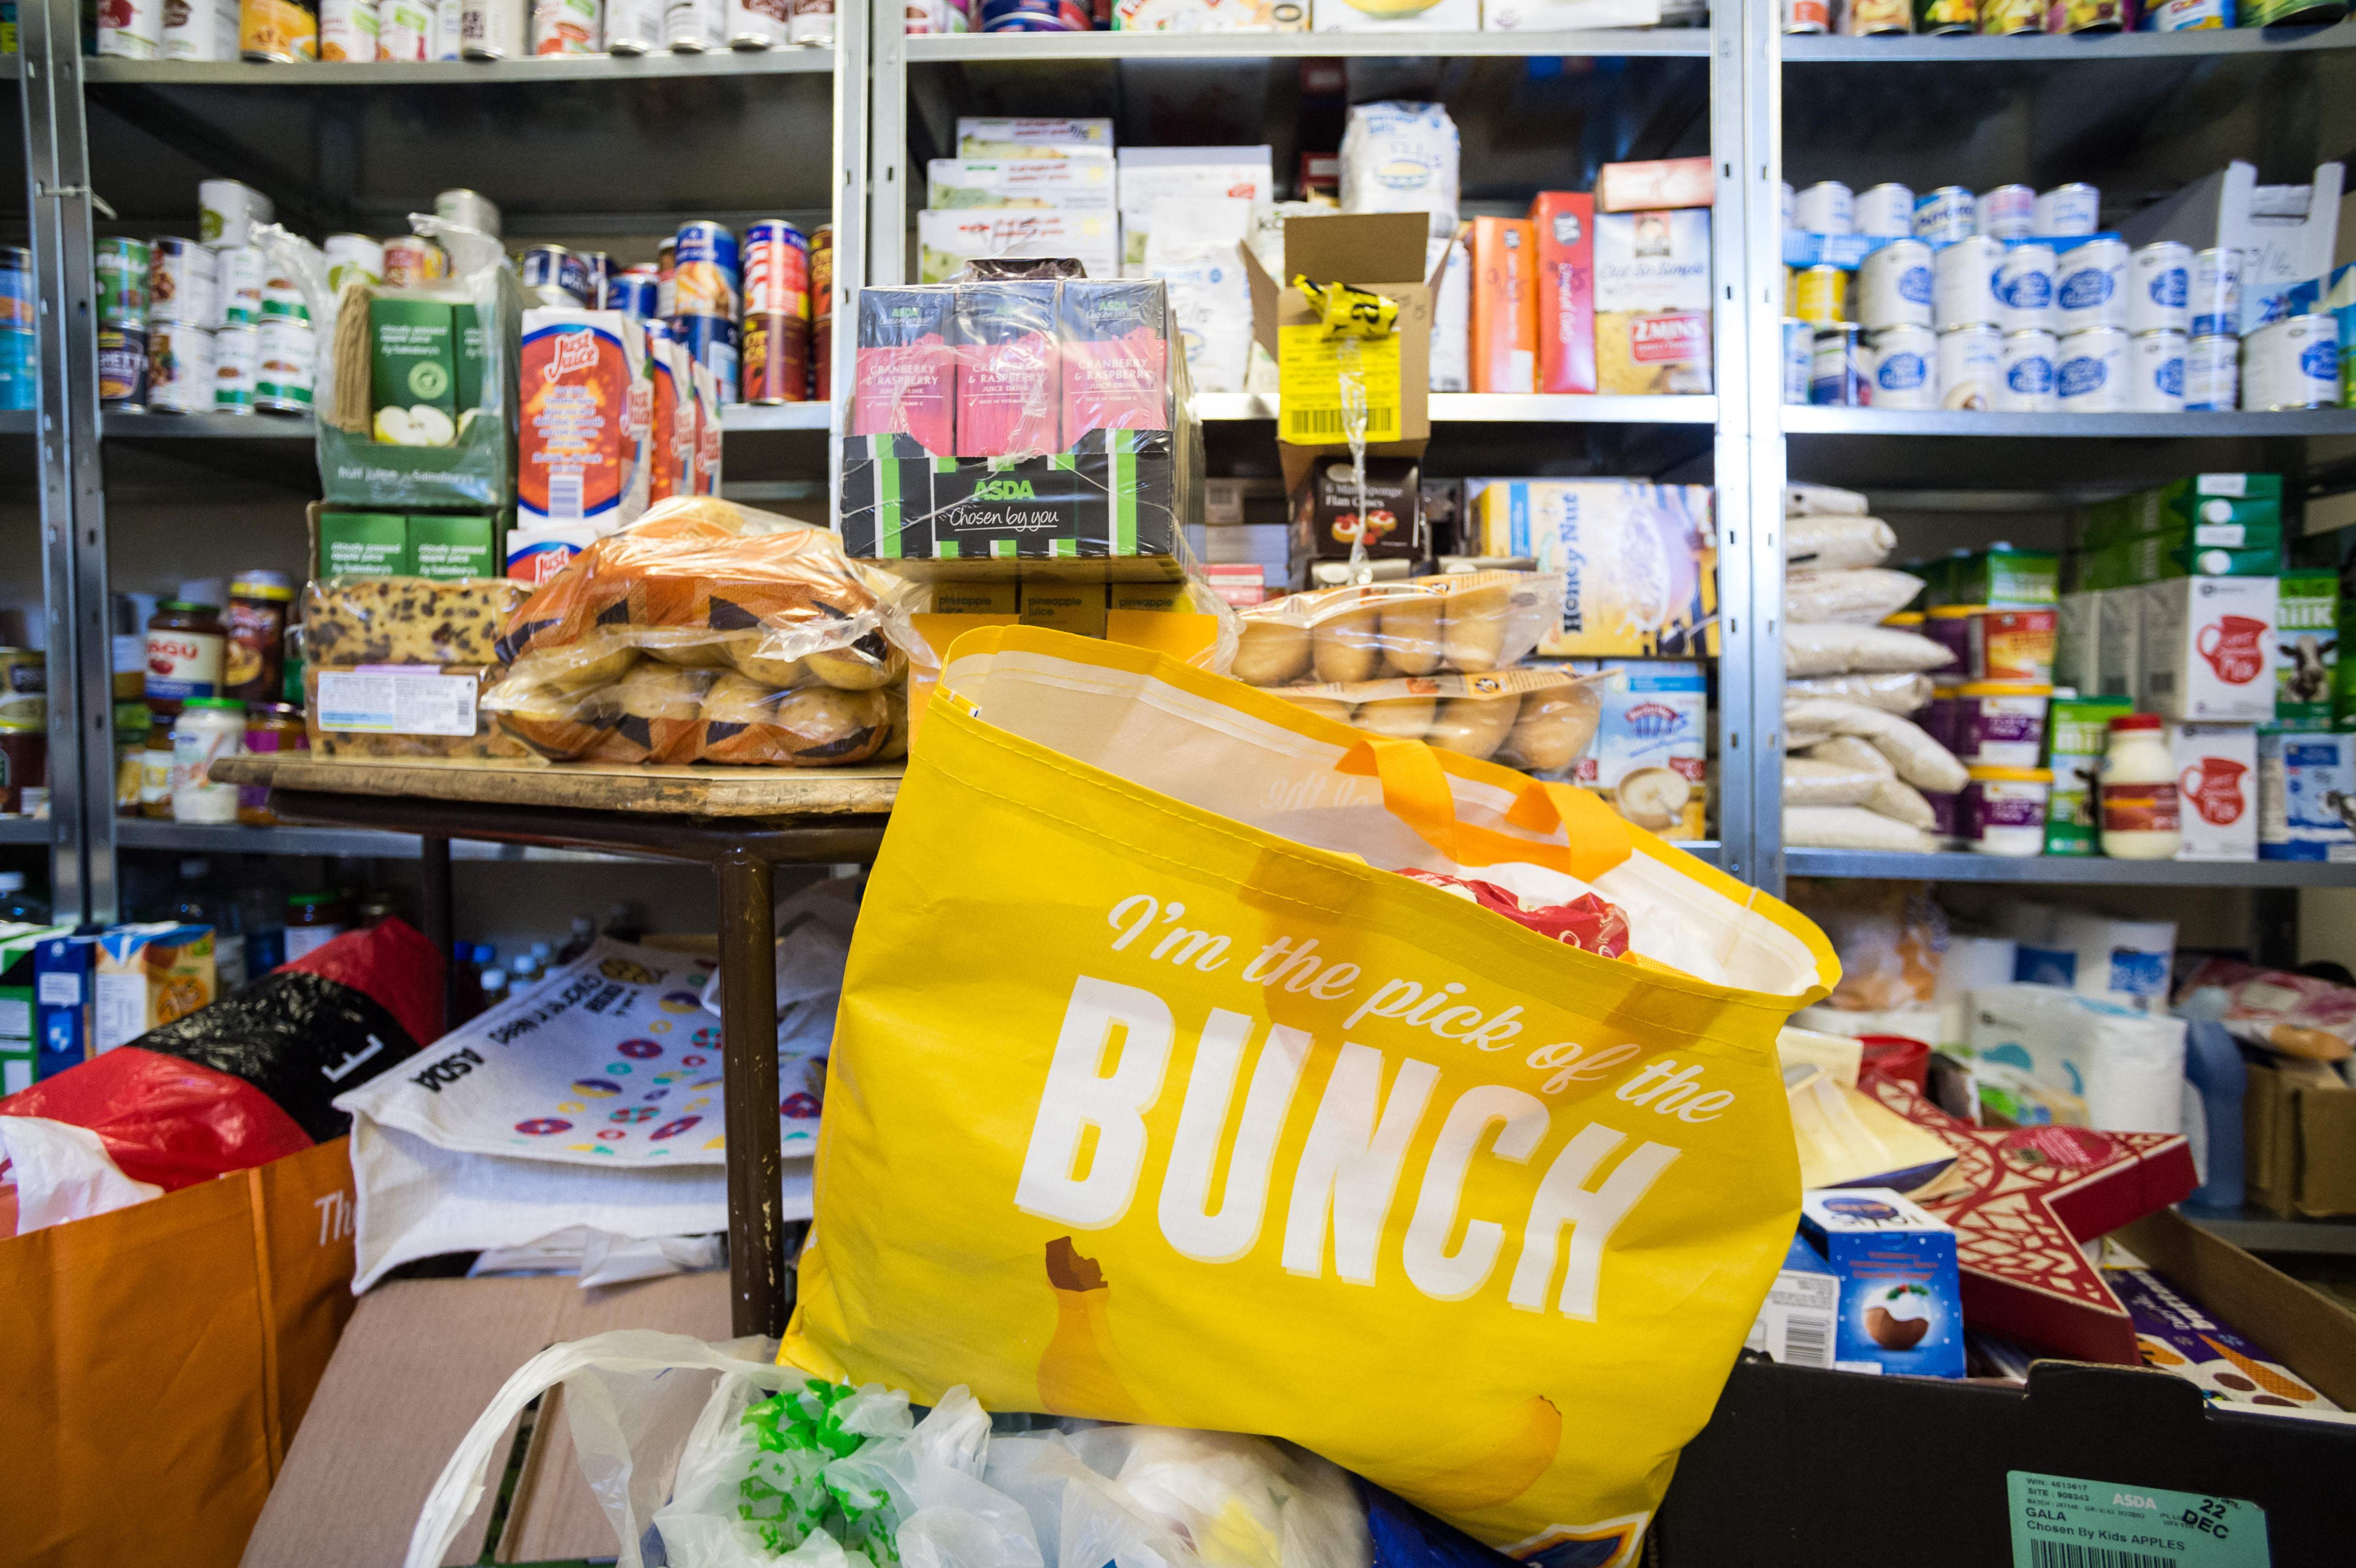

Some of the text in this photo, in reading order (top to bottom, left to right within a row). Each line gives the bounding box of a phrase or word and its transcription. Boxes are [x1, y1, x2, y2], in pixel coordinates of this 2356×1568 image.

[1099, 301, 1129, 311] ASDA
[870, 364, 937, 375] CRANBERRY
[1078, 358, 1148, 369] CRANBERRY
[877, 375, 939, 385] RASPBERRY
[1074, 369, 1154, 381] & RASPBERRY
[974, 480, 1035, 501] ASDA
[1325, 494, 1386, 508] Flan Cses
[950, 506, 1059, 532] Chosen by you
[1560, 492, 1586, 633] Honey Nut
[938, 596, 993, 607] pineapple
[1028, 597, 1083, 607] pineapple
[1118, 598, 1174, 608] pineapple
[1028, 607, 1054, 617] juice
[1107, 893, 1737, 1124] I'm the pick of the
[409, 1047, 485, 1094] ASDA
[1013, 974, 1683, 1324] BUNCH
[2027, 1487, 2049, 1496] SITE
[2112, 1493, 2157, 1510] ASDA
[2026, 1507, 2067, 1521] GALA
[2198, 1498, 2227, 1520] 22
[2181, 1508, 2229, 1539] DEC
[2027, 1520, 2186, 1551] Chosen By Kids APPLES
